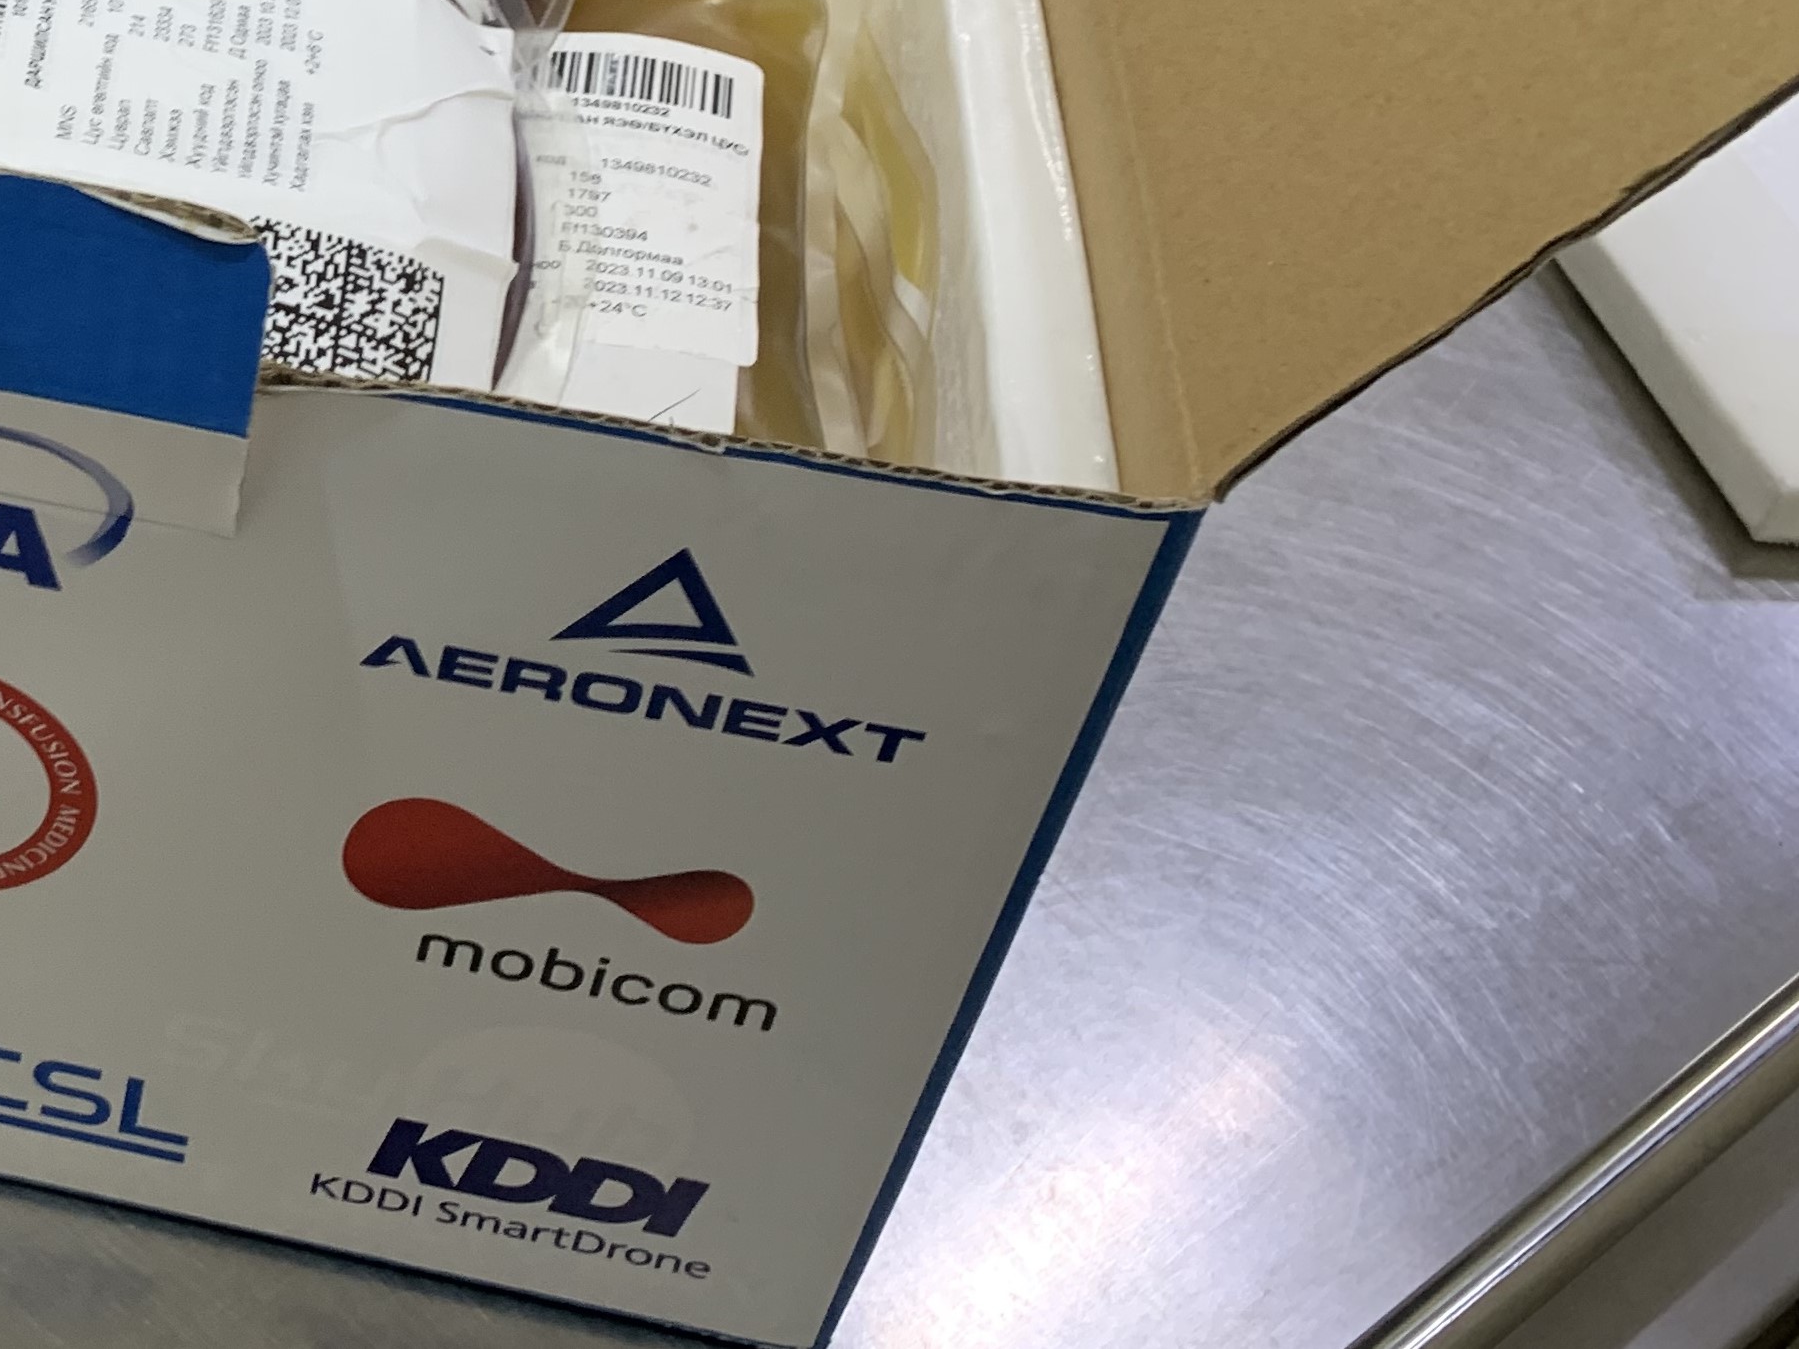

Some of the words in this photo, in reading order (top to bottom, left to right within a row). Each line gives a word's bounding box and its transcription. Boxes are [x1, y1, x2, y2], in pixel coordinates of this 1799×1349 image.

[56, 106, 77, 140] MNS
[359, 635, 927, 763] AERONEXT
[416, 933, 778, 1032] mobicom
[309, 1172, 424, 1217] KDDI
[436, 1199, 712, 1280] SmartDrone
[366, 1116, 711, 1238] KDDI
